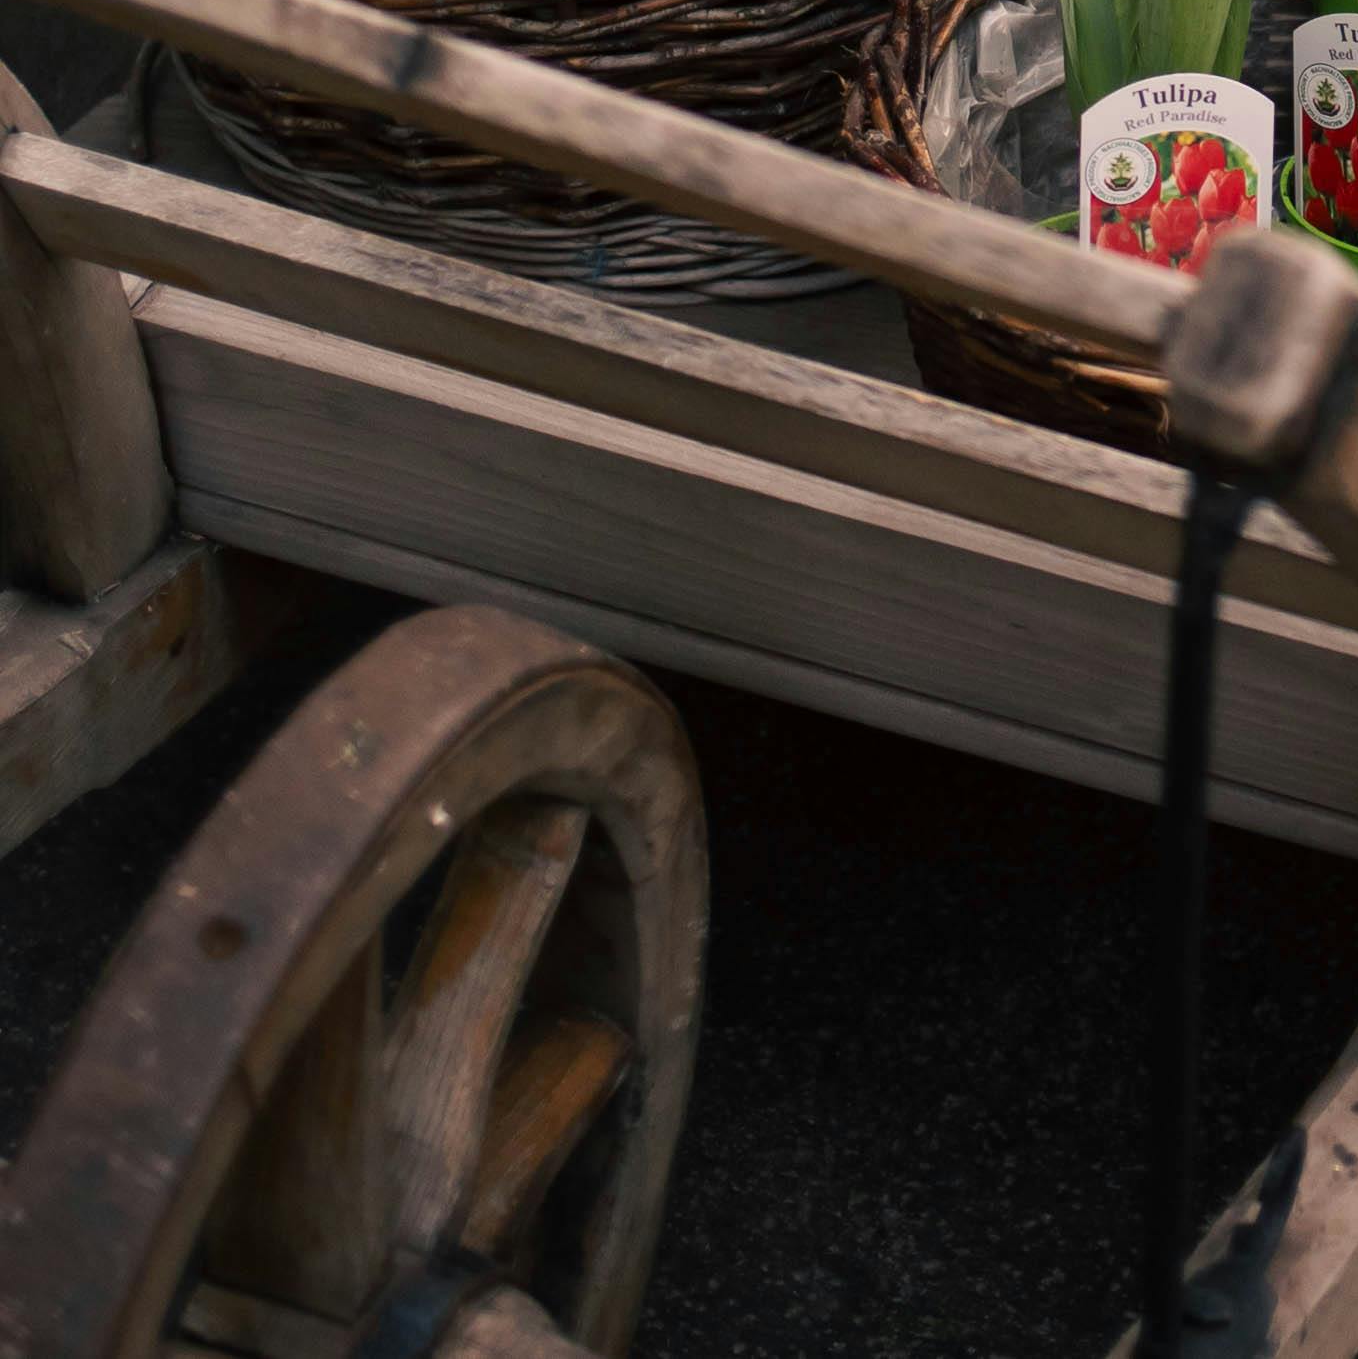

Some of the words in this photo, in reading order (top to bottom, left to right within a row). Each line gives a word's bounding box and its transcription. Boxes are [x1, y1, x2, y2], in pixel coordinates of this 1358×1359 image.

[1328, 48, 1354, 62] Red
[1132, 83, 1218, 109] Tulipa
[1123, 112, 1156, 132] Red
[1160, 109, 1228, 125] Paradise
